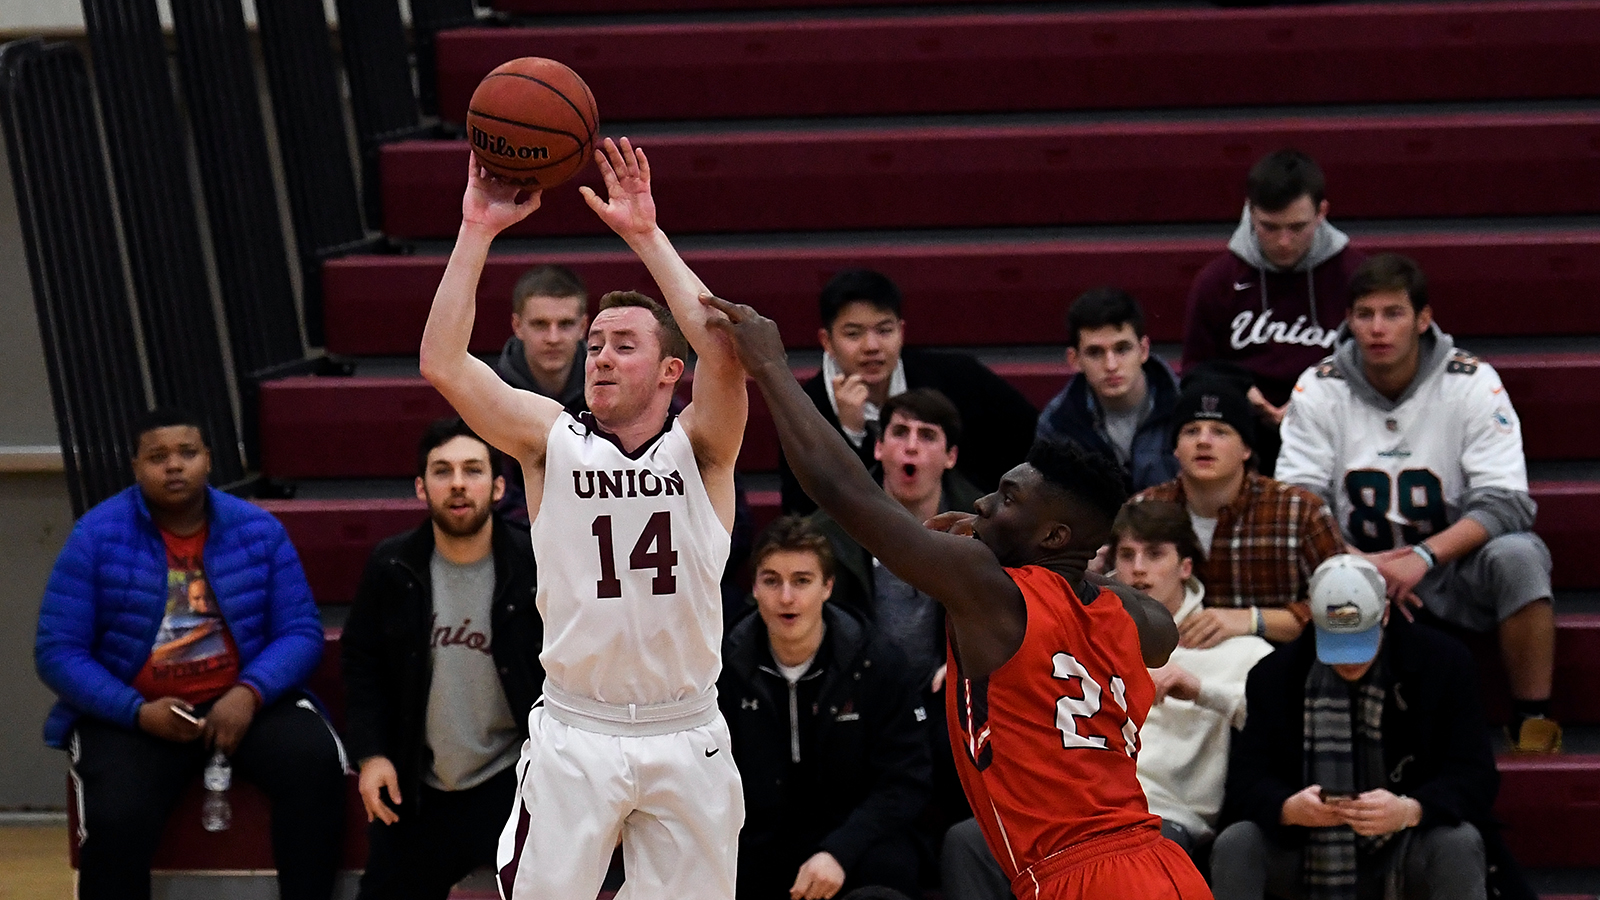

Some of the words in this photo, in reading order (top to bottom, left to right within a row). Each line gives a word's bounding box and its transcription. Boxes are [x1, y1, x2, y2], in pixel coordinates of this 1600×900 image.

[471, 125, 549, 160] Wilson
[572, 468, 685, 499] UNION
[1344, 467, 1450, 553] 89
[591, 511, 679, 599] 14
[430, 612, 493, 656] nio
